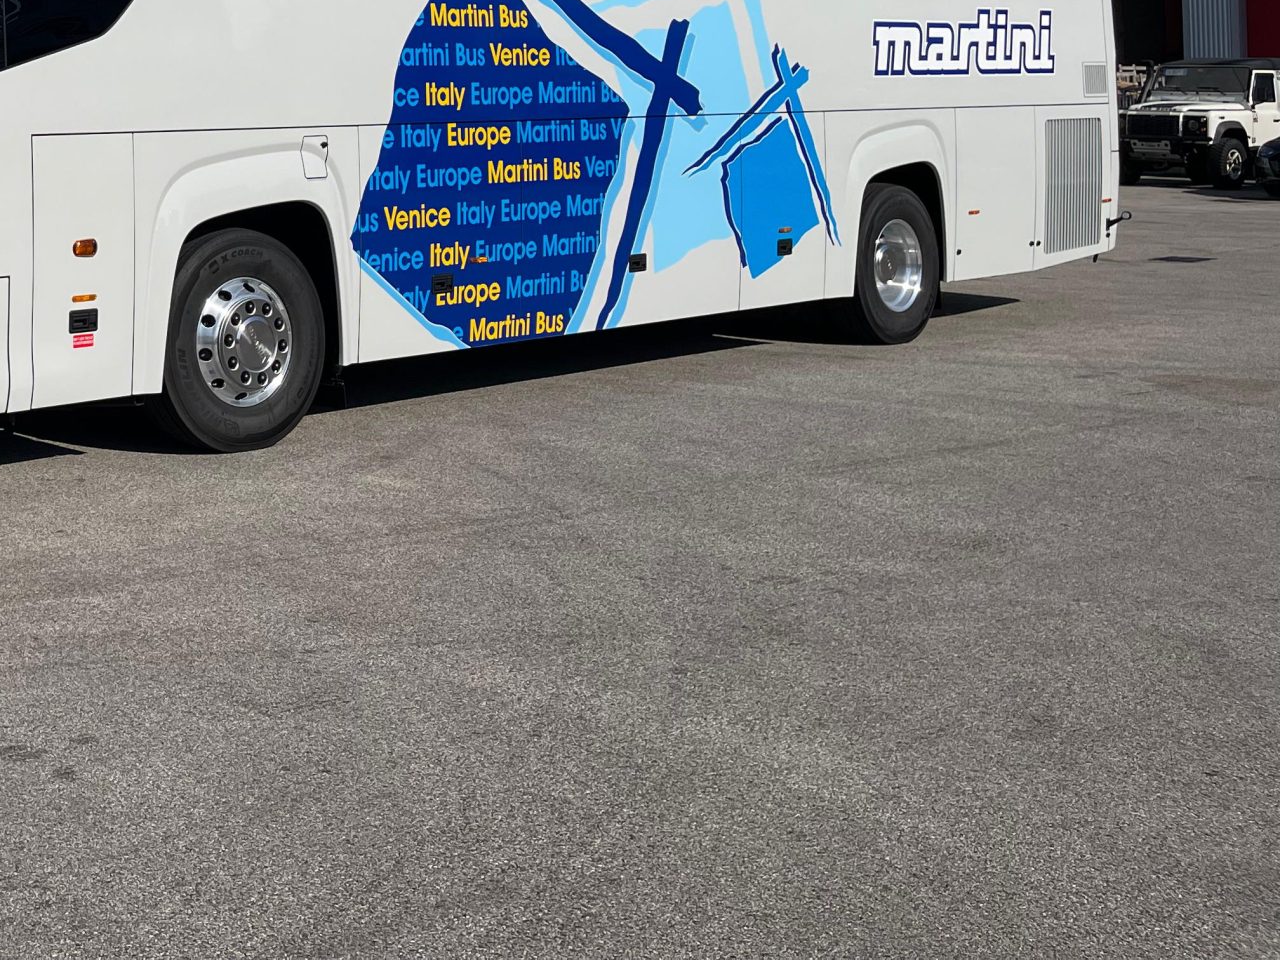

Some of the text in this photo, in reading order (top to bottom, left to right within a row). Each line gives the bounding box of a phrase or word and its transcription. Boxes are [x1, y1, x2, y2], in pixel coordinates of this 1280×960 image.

[430, 3, 493, 26] Martini
[500, 5, 528, 28] Bus
[398, 44, 450, 66] artini
[456, 43, 485, 66] Bus
[490, 44, 550, 66] Venice
[873, 9, 1055, 75] martini
[426, 84, 465, 108] Italy
[471, 82, 533, 109] Europe
[539, 81, 595, 103] Martini
[401, 124, 441, 152] Italy
[448, 123, 511, 148] Europe
[517, 120, 574, 143] Martini
[580, 120, 606, 140] Bus
[417, 164, 482, 190] Europe
[488, 161, 547, 183] Martini
[554, 158, 580, 179] Bus
[384, 206, 450, 229] Venice
[457, 201, 495, 228] Italy
[501, 199, 561, 224] Europe
[431, 244, 469, 267] Italy
[476, 240, 537, 265] Europe
[506, 272, 565, 299] Martini
[470, 315, 530, 340] Martini
[536, 312, 563, 334] Bus
